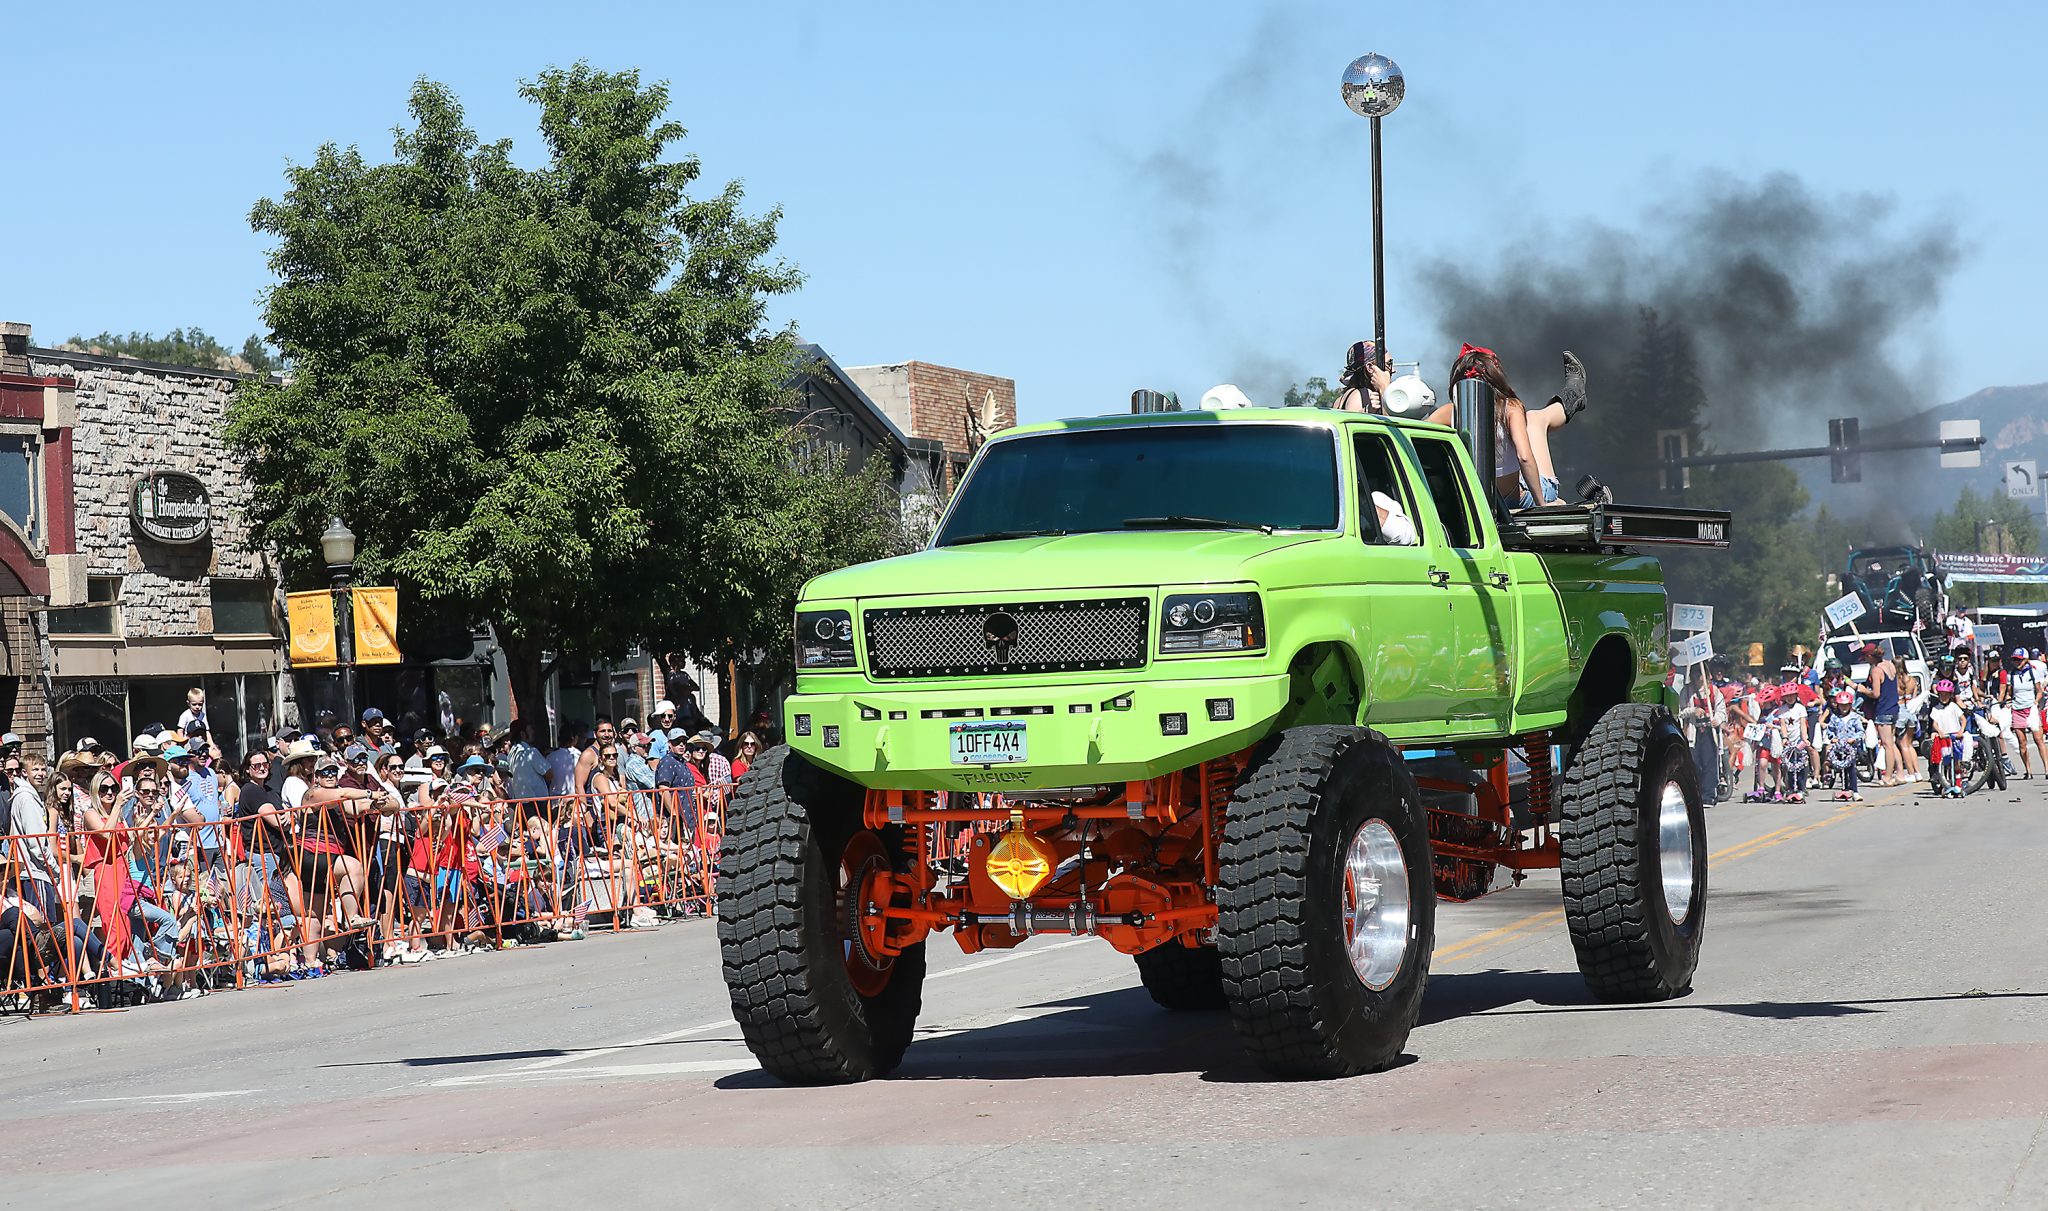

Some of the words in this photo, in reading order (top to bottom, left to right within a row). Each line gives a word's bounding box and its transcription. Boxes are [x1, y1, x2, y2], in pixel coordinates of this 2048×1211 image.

[157, 477, 168, 496] the
[2012, 487, 2034, 496] ONLY
[157, 495, 210, 519] Homesteader
[147, 521, 171, 539] GOURMET
[193, 518, 206, 536] SHOP
[1976, 554, 2004, 563] MUSIC
[2004, 554, 2043, 564] FESTIVAL
[1680, 607, 1705, 620] 373
[1690, 642, 1707, 657] 125
[953, 771, 1032, 786] FUSION
